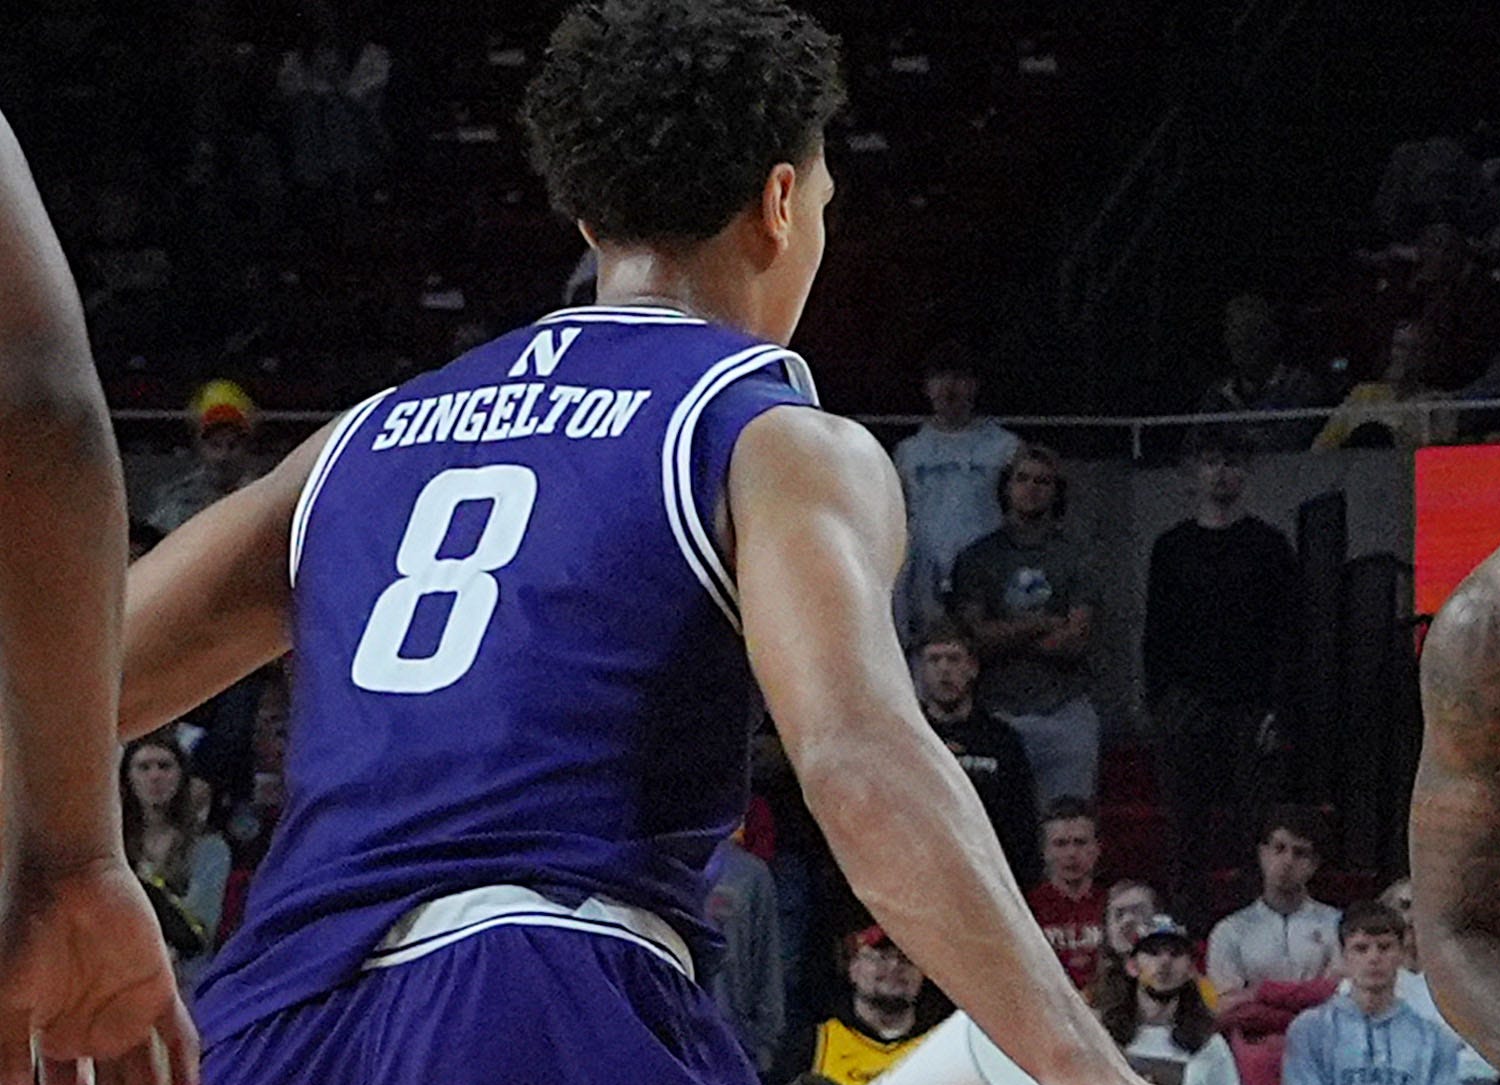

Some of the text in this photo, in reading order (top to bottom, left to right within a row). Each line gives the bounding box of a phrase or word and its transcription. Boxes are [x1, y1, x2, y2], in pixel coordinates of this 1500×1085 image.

[508, 327, 582, 377] N
[372, 383, 651, 450] SINGELTON
[351, 464, 537, 693] 8
